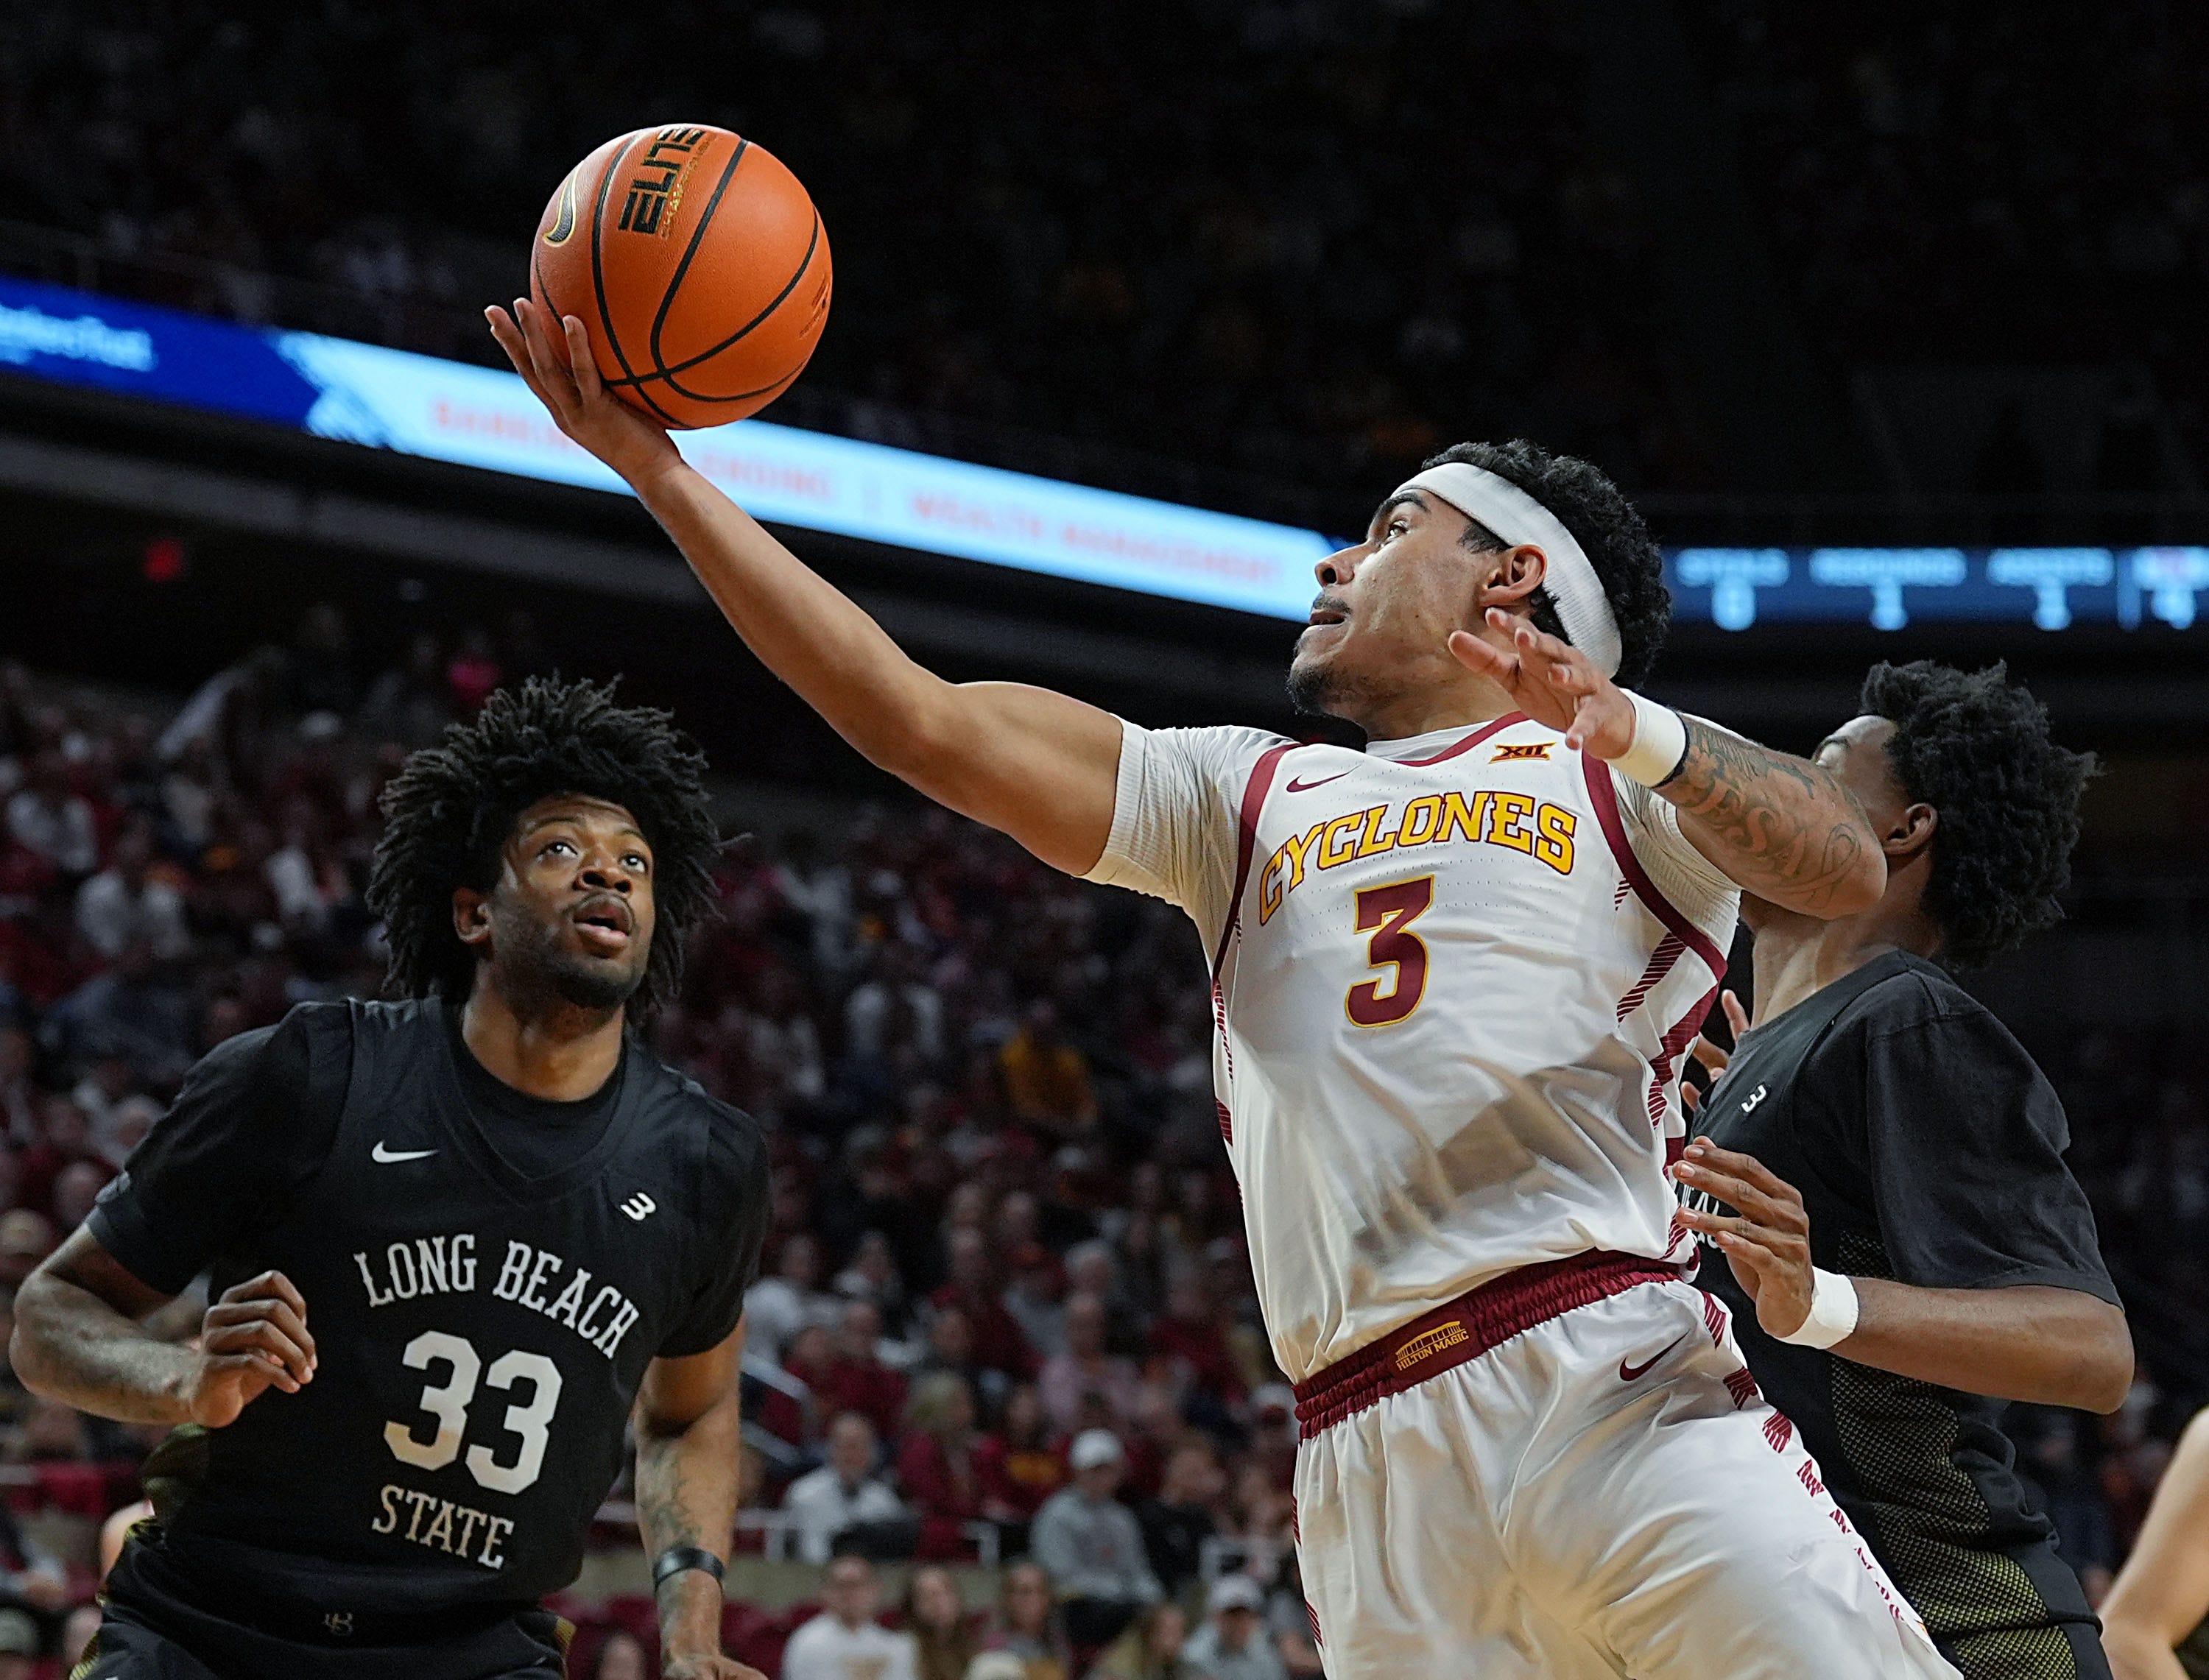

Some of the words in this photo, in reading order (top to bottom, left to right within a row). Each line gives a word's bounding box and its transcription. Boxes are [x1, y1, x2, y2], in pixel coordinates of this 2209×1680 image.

[617, 127, 707, 236] ELITE
[1259, 791, 1577, 927] CYCLONES
[1345, 874, 1434, 1028] 3
[353, 1234, 477, 1307] LONG
[493, 1240, 640, 1360] BEACH
[1396, 1347, 1433, 1371] HILTON
[1435, 1330, 1470, 1352] MAGIC
[383, 1330, 563, 1494] 33
[372, 1483, 514, 1570] STATE
